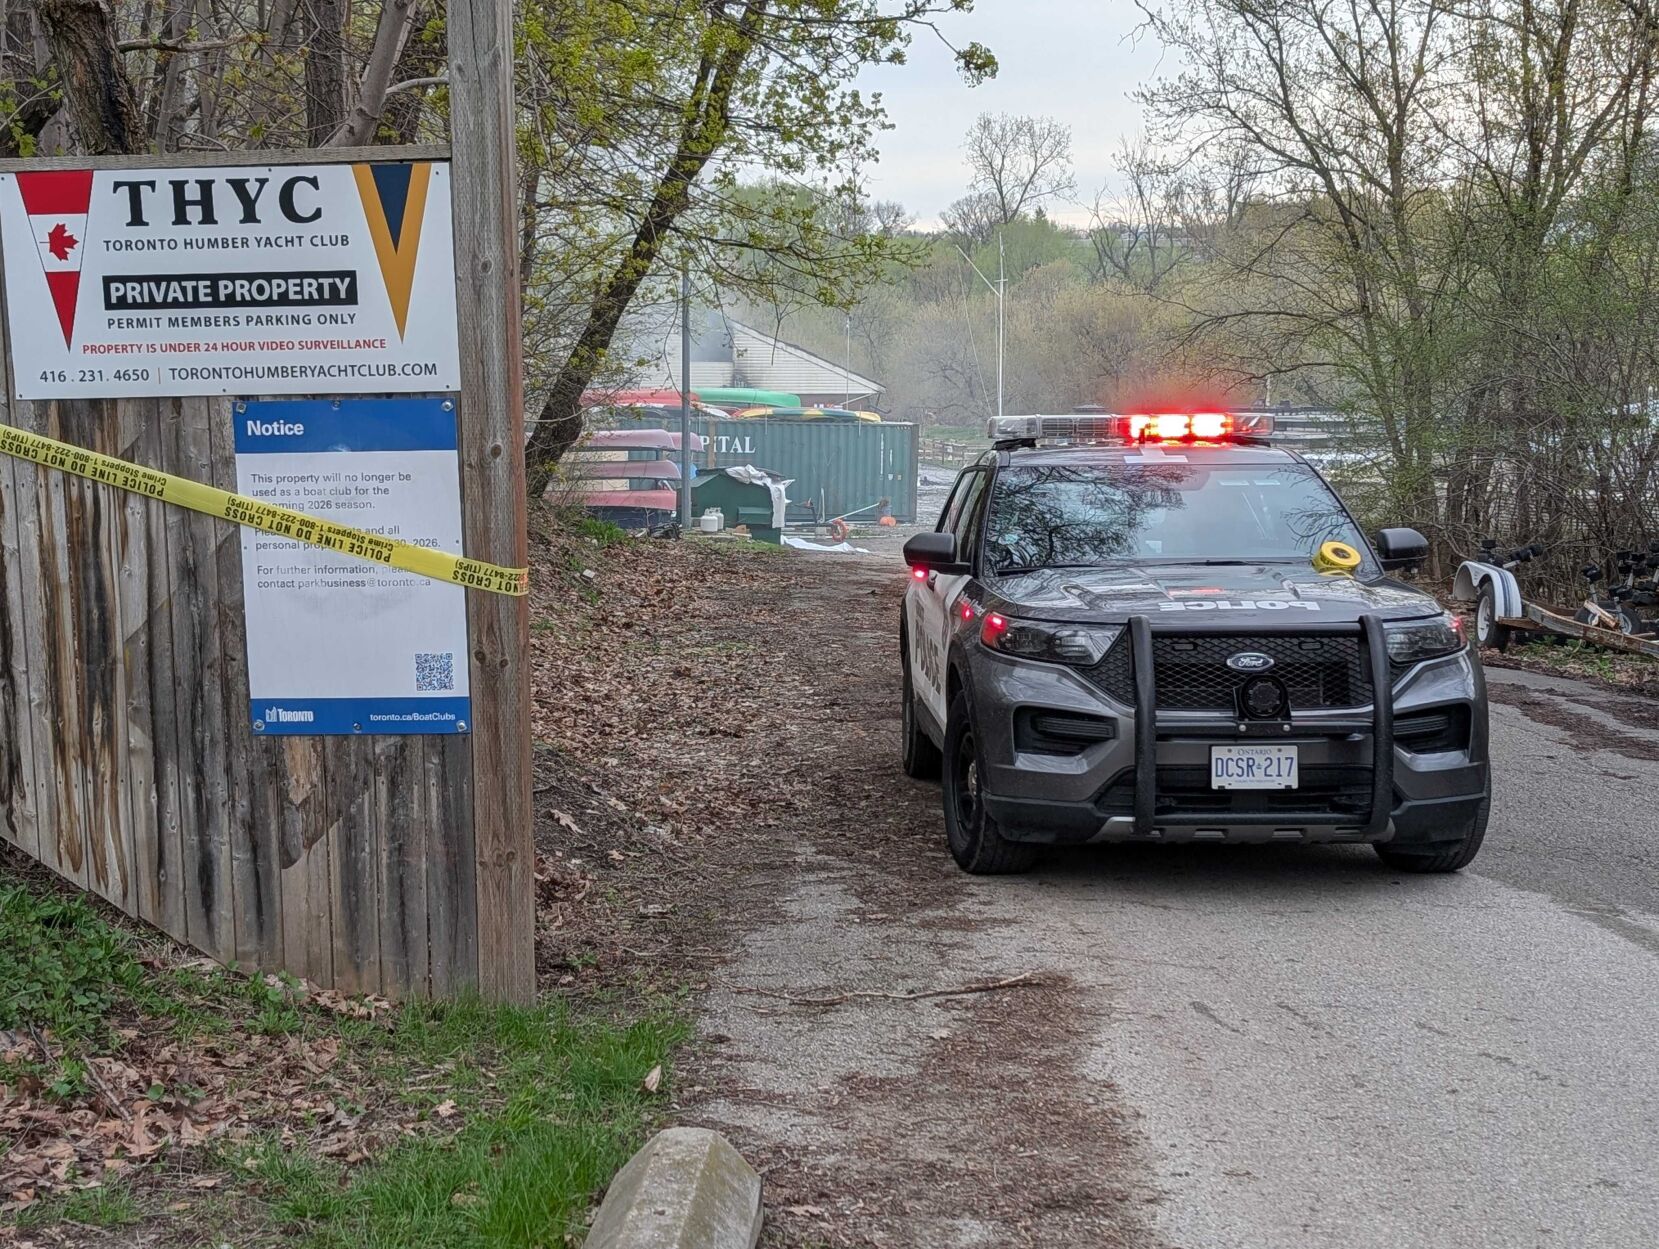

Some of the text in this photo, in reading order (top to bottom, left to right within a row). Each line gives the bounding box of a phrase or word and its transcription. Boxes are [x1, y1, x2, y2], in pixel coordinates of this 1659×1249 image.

[112, 175, 323, 227] THYC
[103, 234, 350, 252] TORONTO HUMBER YACHT CLUB
[110, 277, 351, 303] PRIVATE PROPERTY
[107, 312, 356, 329] PERMIT MEMBERS PARKING ONLY
[82, 338, 386, 354] PROPERTY IS UNDER 24 HOUR VIDEO SURVEILLANCE
[168, 363, 438, 381] TORONTOHUMBERYACHTCLUB.COM
[247, 420, 304, 436] Notice
[2, 428, 167, 486] Crime Stoppers 1-800-222-8477 (TIPS)
[0, 439, 164, 497] POLICE LINE DO NOT CROSS
[250, 473, 273, 484] This
[276, 474, 320, 485] property
[322, 473, 341, 482] will
[361, 472, 396, 483] longer
[398, 472, 412, 481] be
[252, 487, 277, 497] used
[303, 487, 327, 496] boat
[329, 486, 352, 496] club
[354, 486, 370, 496] for
[373, 486, 390, 495] the
[307, 500, 332, 510] 2026
[335, 501, 376, 509] season.
[228, 496, 394, 552] Crime Stoppers 1-800-222-8477 (TIPS)
[362, 525, 385, 535] and
[387, 525, 400, 535] all
[224, 506, 392, 563] POLICE LINE DO NOT CROSS
[255, 541, 300, 551] personal
[412, 538, 441, 548] 2026.
[257, 565, 274, 575] For
[276, 565, 311, 575] further
[314, 565, 378, 576] information,
[455, 558, 481, 574] (TIPS)
[257, 578, 431, 590] contact parkbusiness@toronto.ca
[452, 570, 492, 588] CROSS
[496, 580, 519, 593] NOT
[278, 708, 314, 722] TORONTO
[369, 712, 456, 721] toronto.ca/BoatClubs
[1237, 748, 1272, 756] ONTARIO
